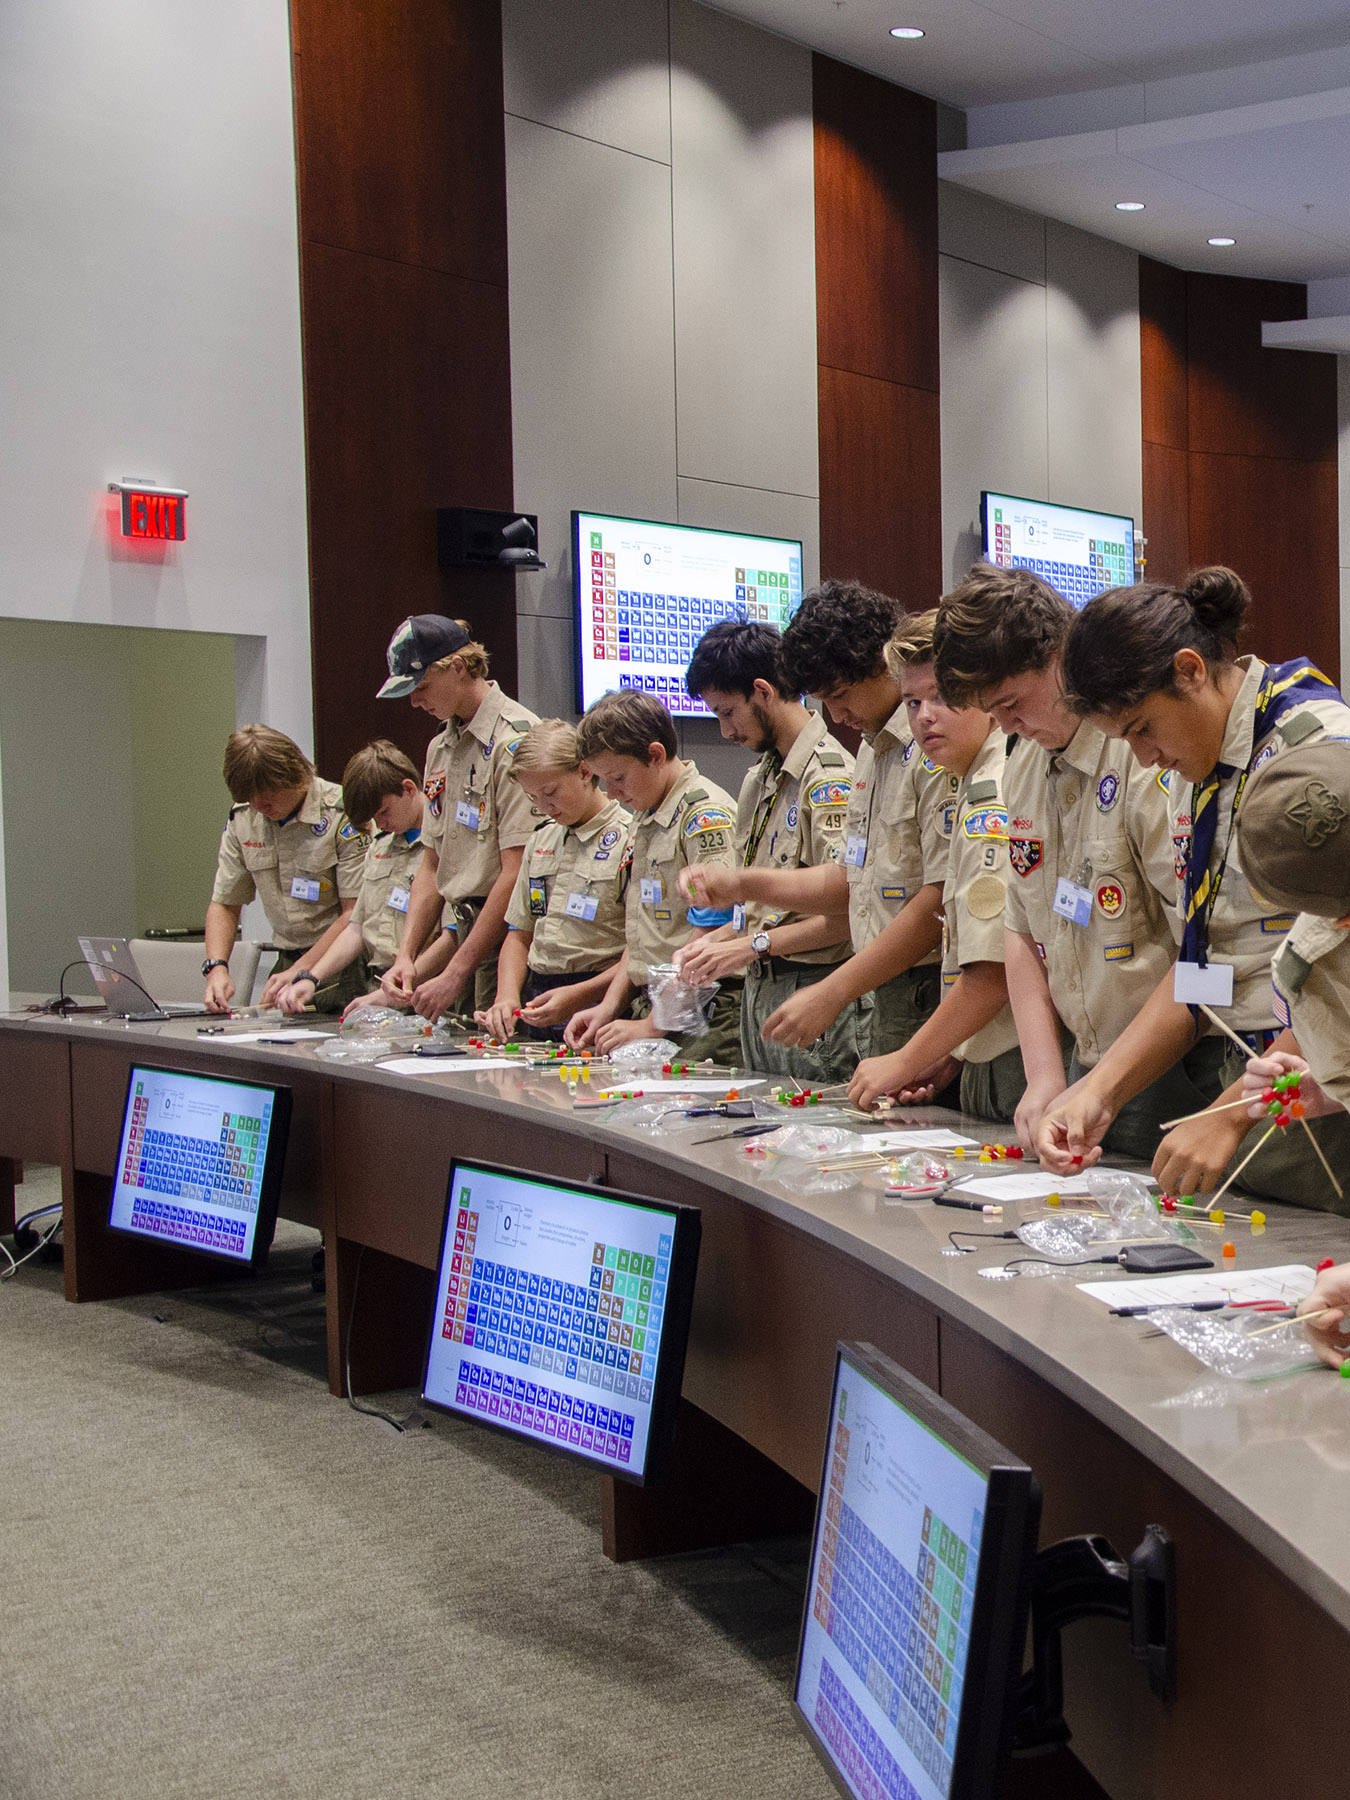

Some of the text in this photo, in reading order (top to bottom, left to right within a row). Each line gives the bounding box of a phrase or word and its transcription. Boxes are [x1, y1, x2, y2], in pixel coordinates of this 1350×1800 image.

[130, 493, 179, 540] EXIT
[950, 776, 959, 794] 9
[826, 814, 846, 828] 49
[1020, 820, 1033, 830] BSA
[700, 832, 724, 848] 323
[984, 848, 995, 866] 9
[646, 1261, 650, 1270] F
[507, 1272, 514, 1282] Cr
[530, 1278, 537, 1289] Fe
[541, 1282, 549, 1292] Co
[564, 1288, 572, 1299] Cu
[576, 1289, 584, 1302] Zn
[588, 1295, 596, 1306] Ga
[613, 1302, 620, 1312] As
[592, 1272, 599, 1282] Al
[604, 1275, 611, 1285] Si
[642, 1285, 648, 1295] Cl
[482, 1287, 489, 1298] Zr
[549, 1306, 558, 1318] Pd
[561, 1311, 569, 1324] Ag
[573, 1315, 581, 1326] Cd
[586, 1318, 592, 1329] In
[597, 1322, 605, 1333] Sn
[610, 1323, 618, 1336] Sb
[558, 1335, 566, 1345] Au
[569, 1336, 578, 1351] Hg
[594, 1343, 602, 1356] Pb
[619, 1353, 627, 1364] Po
[632, 1357, 639, 1368] At
[567, 1359, 575, 1372] Cn
[538, 1391, 547, 1402] Gd
[561, 1397, 570, 1412] Dy
[574, 1403, 582, 1414] Ho
[586, 1407, 594, 1418] Er
[598, 1409, 607, 1422] Tm
[611, 1414, 618, 1427] Yb
[623, 1418, 631, 1431] Lu
[571, 1425, 578, 1438] Es
[620, 1442, 628, 1455] Lr
